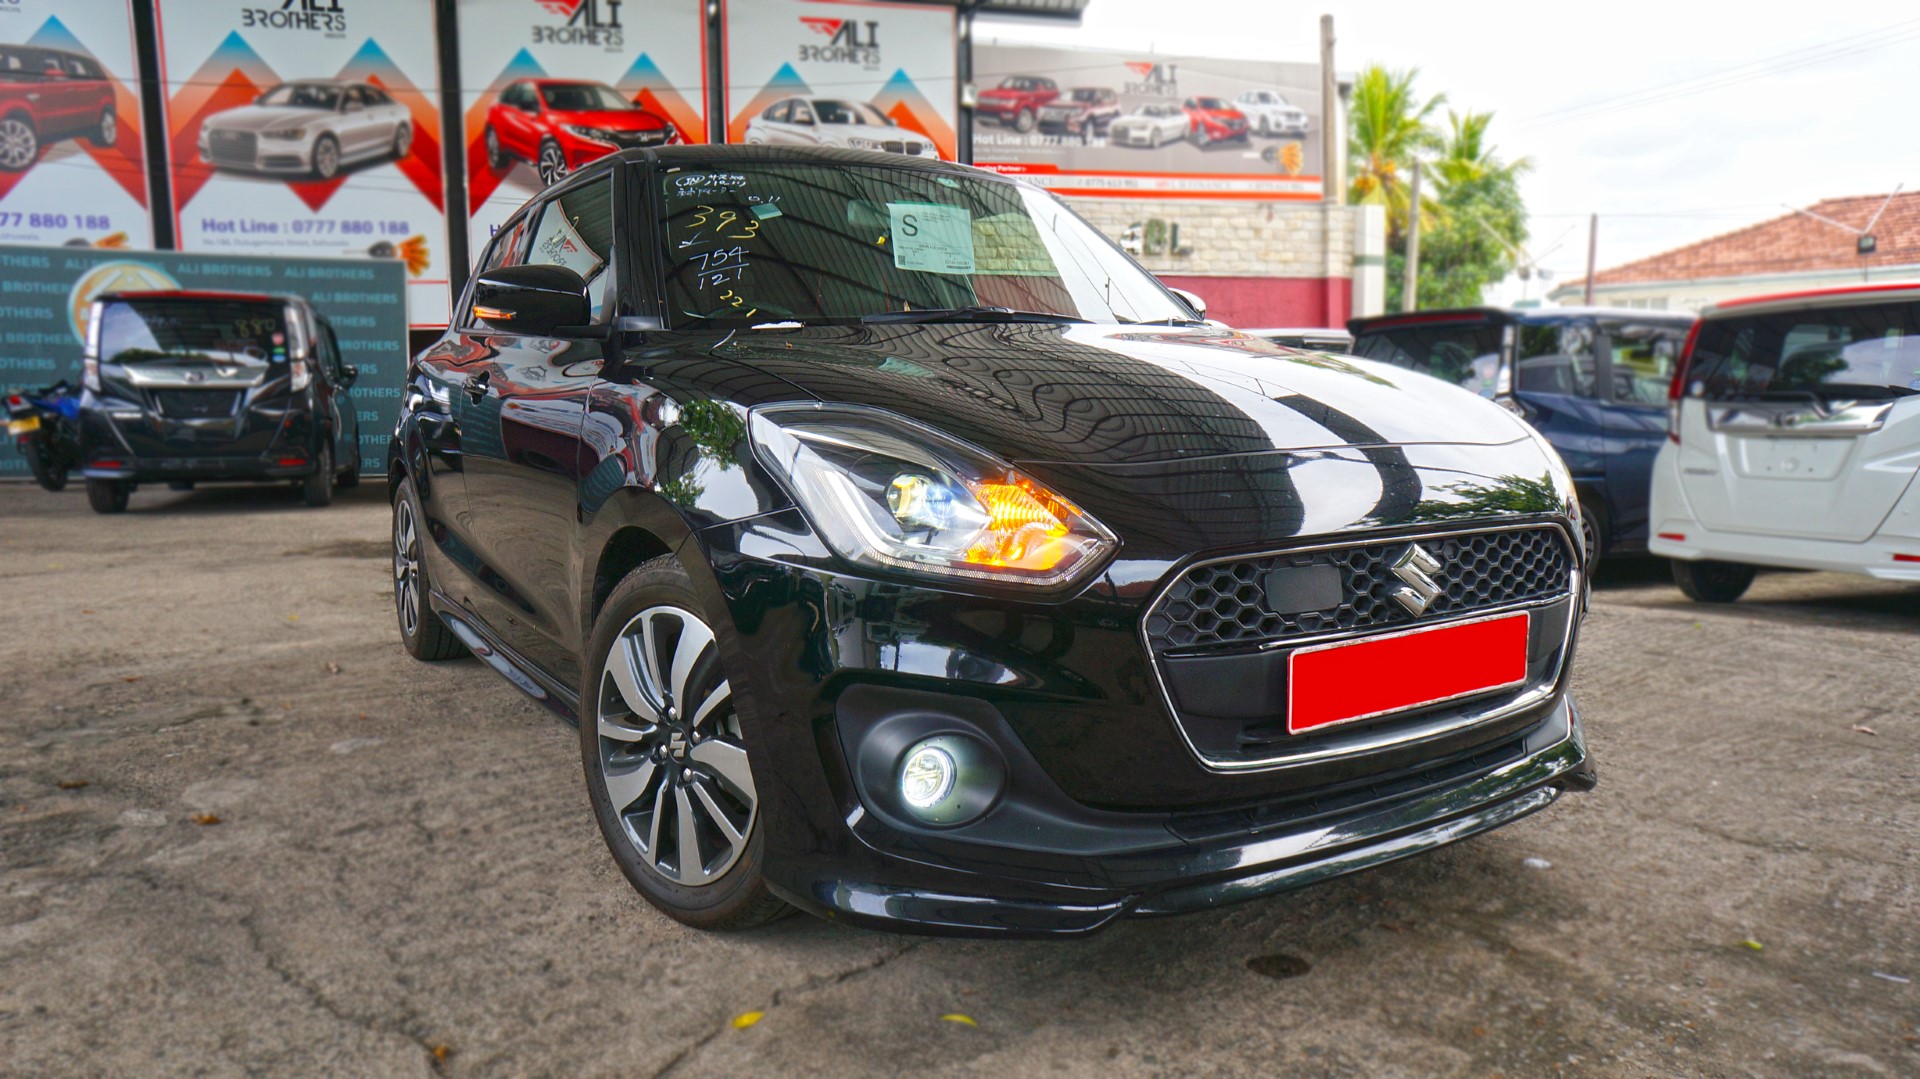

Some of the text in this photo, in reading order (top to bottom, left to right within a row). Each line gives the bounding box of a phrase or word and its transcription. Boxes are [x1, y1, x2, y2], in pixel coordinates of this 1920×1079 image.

[242, 8, 346, 31] BROTHERS
[532, 25, 624, 46] BROTHERS
[831, 19, 879, 48] ALI
[798, 44, 881, 65] BROTHERS
[1145, 64, 1177, 84] ALI
[973, 134, 994, 145] Hot
[997, 134, 1021, 145] Line
[29, 213, 68, 229] 880
[73, 215, 110, 230] 188
[201, 218, 236, 233] Hot
[240, 219, 278, 234] Line
[291, 219, 336, 234] 0777
[340, 220, 373, 235] 880
[379, 221, 409, 235] 188
[685, 205, 759, 238] 393
[902, 213, 918, 237] S
[0, 256, 50, 268] THERS
[689, 246, 750, 270] 754
[177, 262, 199, 274] ALI
[202, 263, 272, 277] BROTHERS
[284, 266, 375, 280] ALI BROTHERS
[699, 268, 742, 290] 121
[3, 281, 73, 294] BROTHER
[312, 292, 398, 305] ALI BROTHERS
